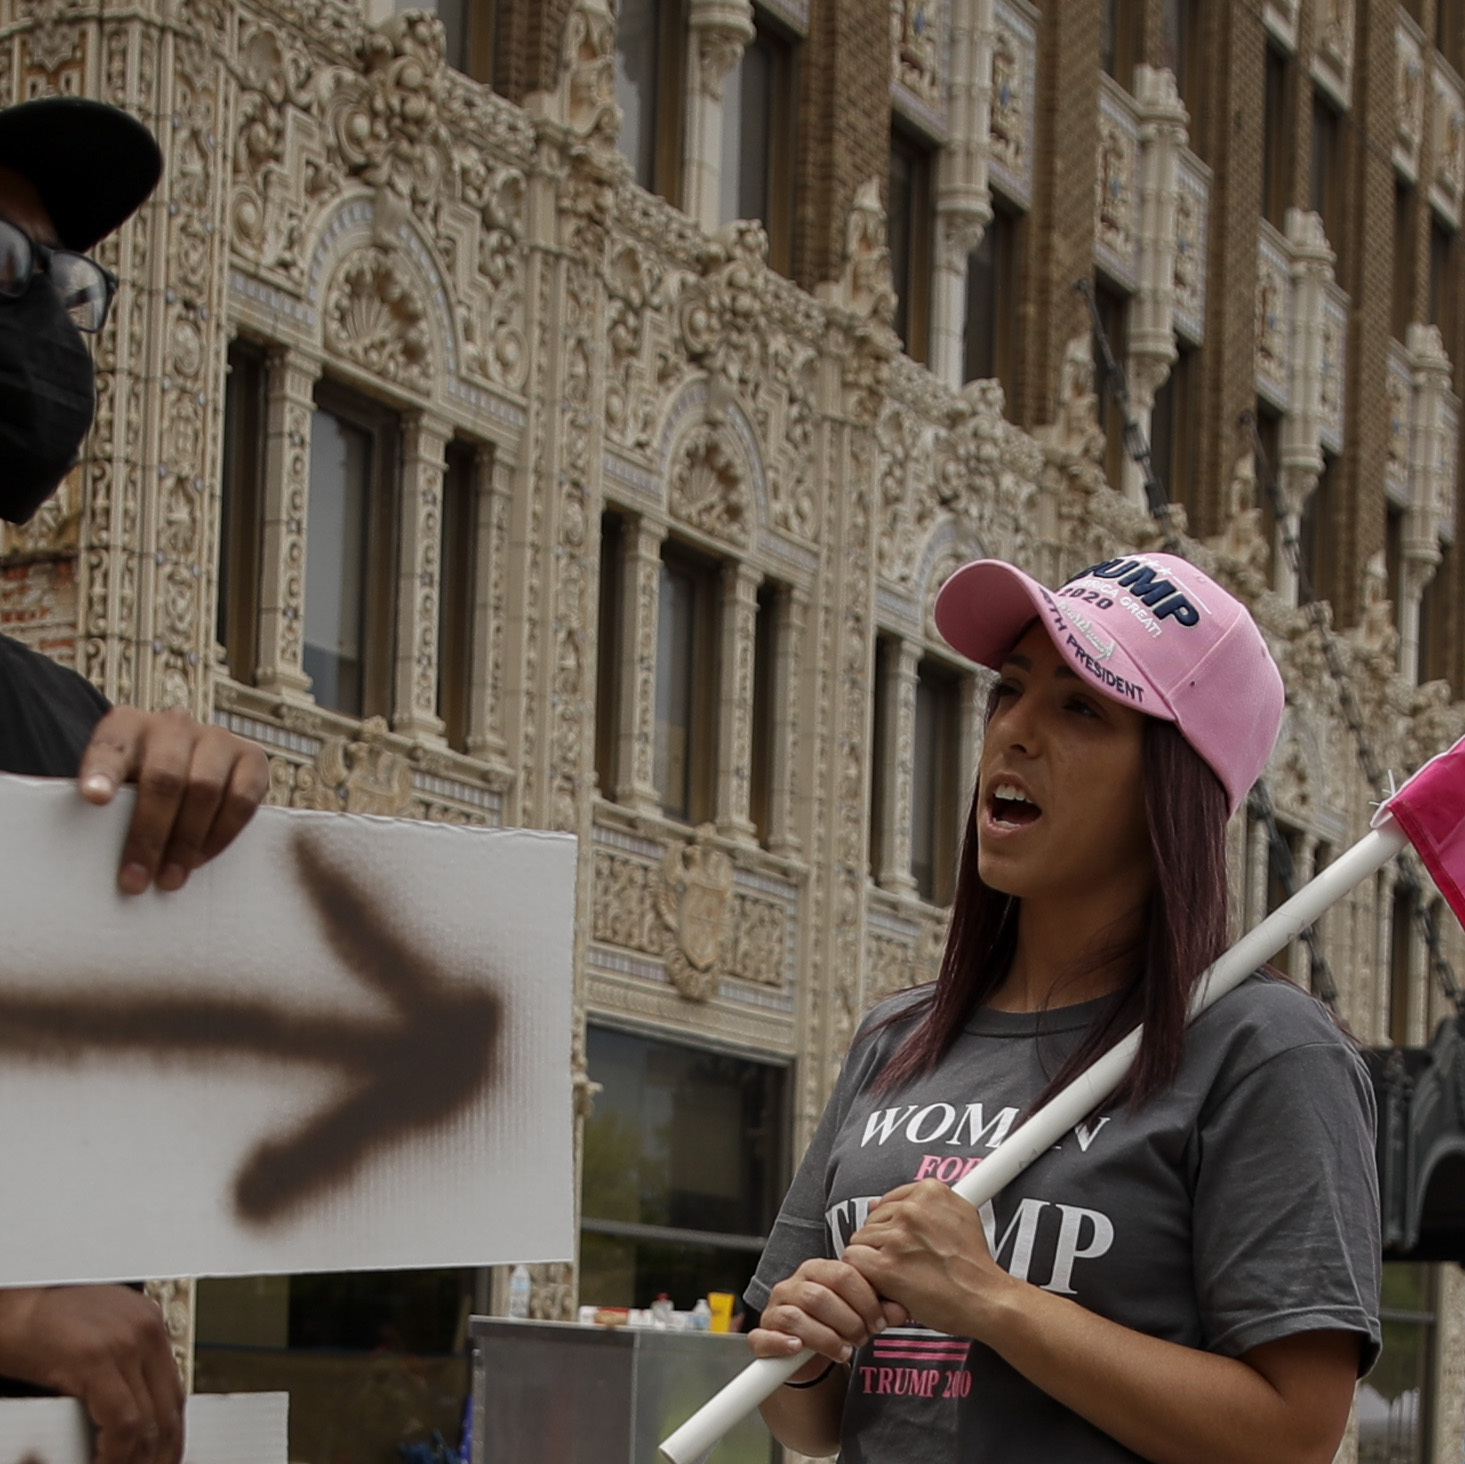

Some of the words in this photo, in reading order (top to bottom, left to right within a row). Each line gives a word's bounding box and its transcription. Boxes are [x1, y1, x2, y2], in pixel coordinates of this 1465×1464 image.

[1058, 557, 1201, 627] UMP
[1058, 587, 1114, 610] 2020
[1119, 595, 1164, 638] GREAT!
[1065, 632, 1145, 703] PRESIDENT
[860, 1102, 1111, 1152] WOMN
[824, 1196, 1115, 1295] TMP
[859, 1366, 940, 1398] TRUMP
